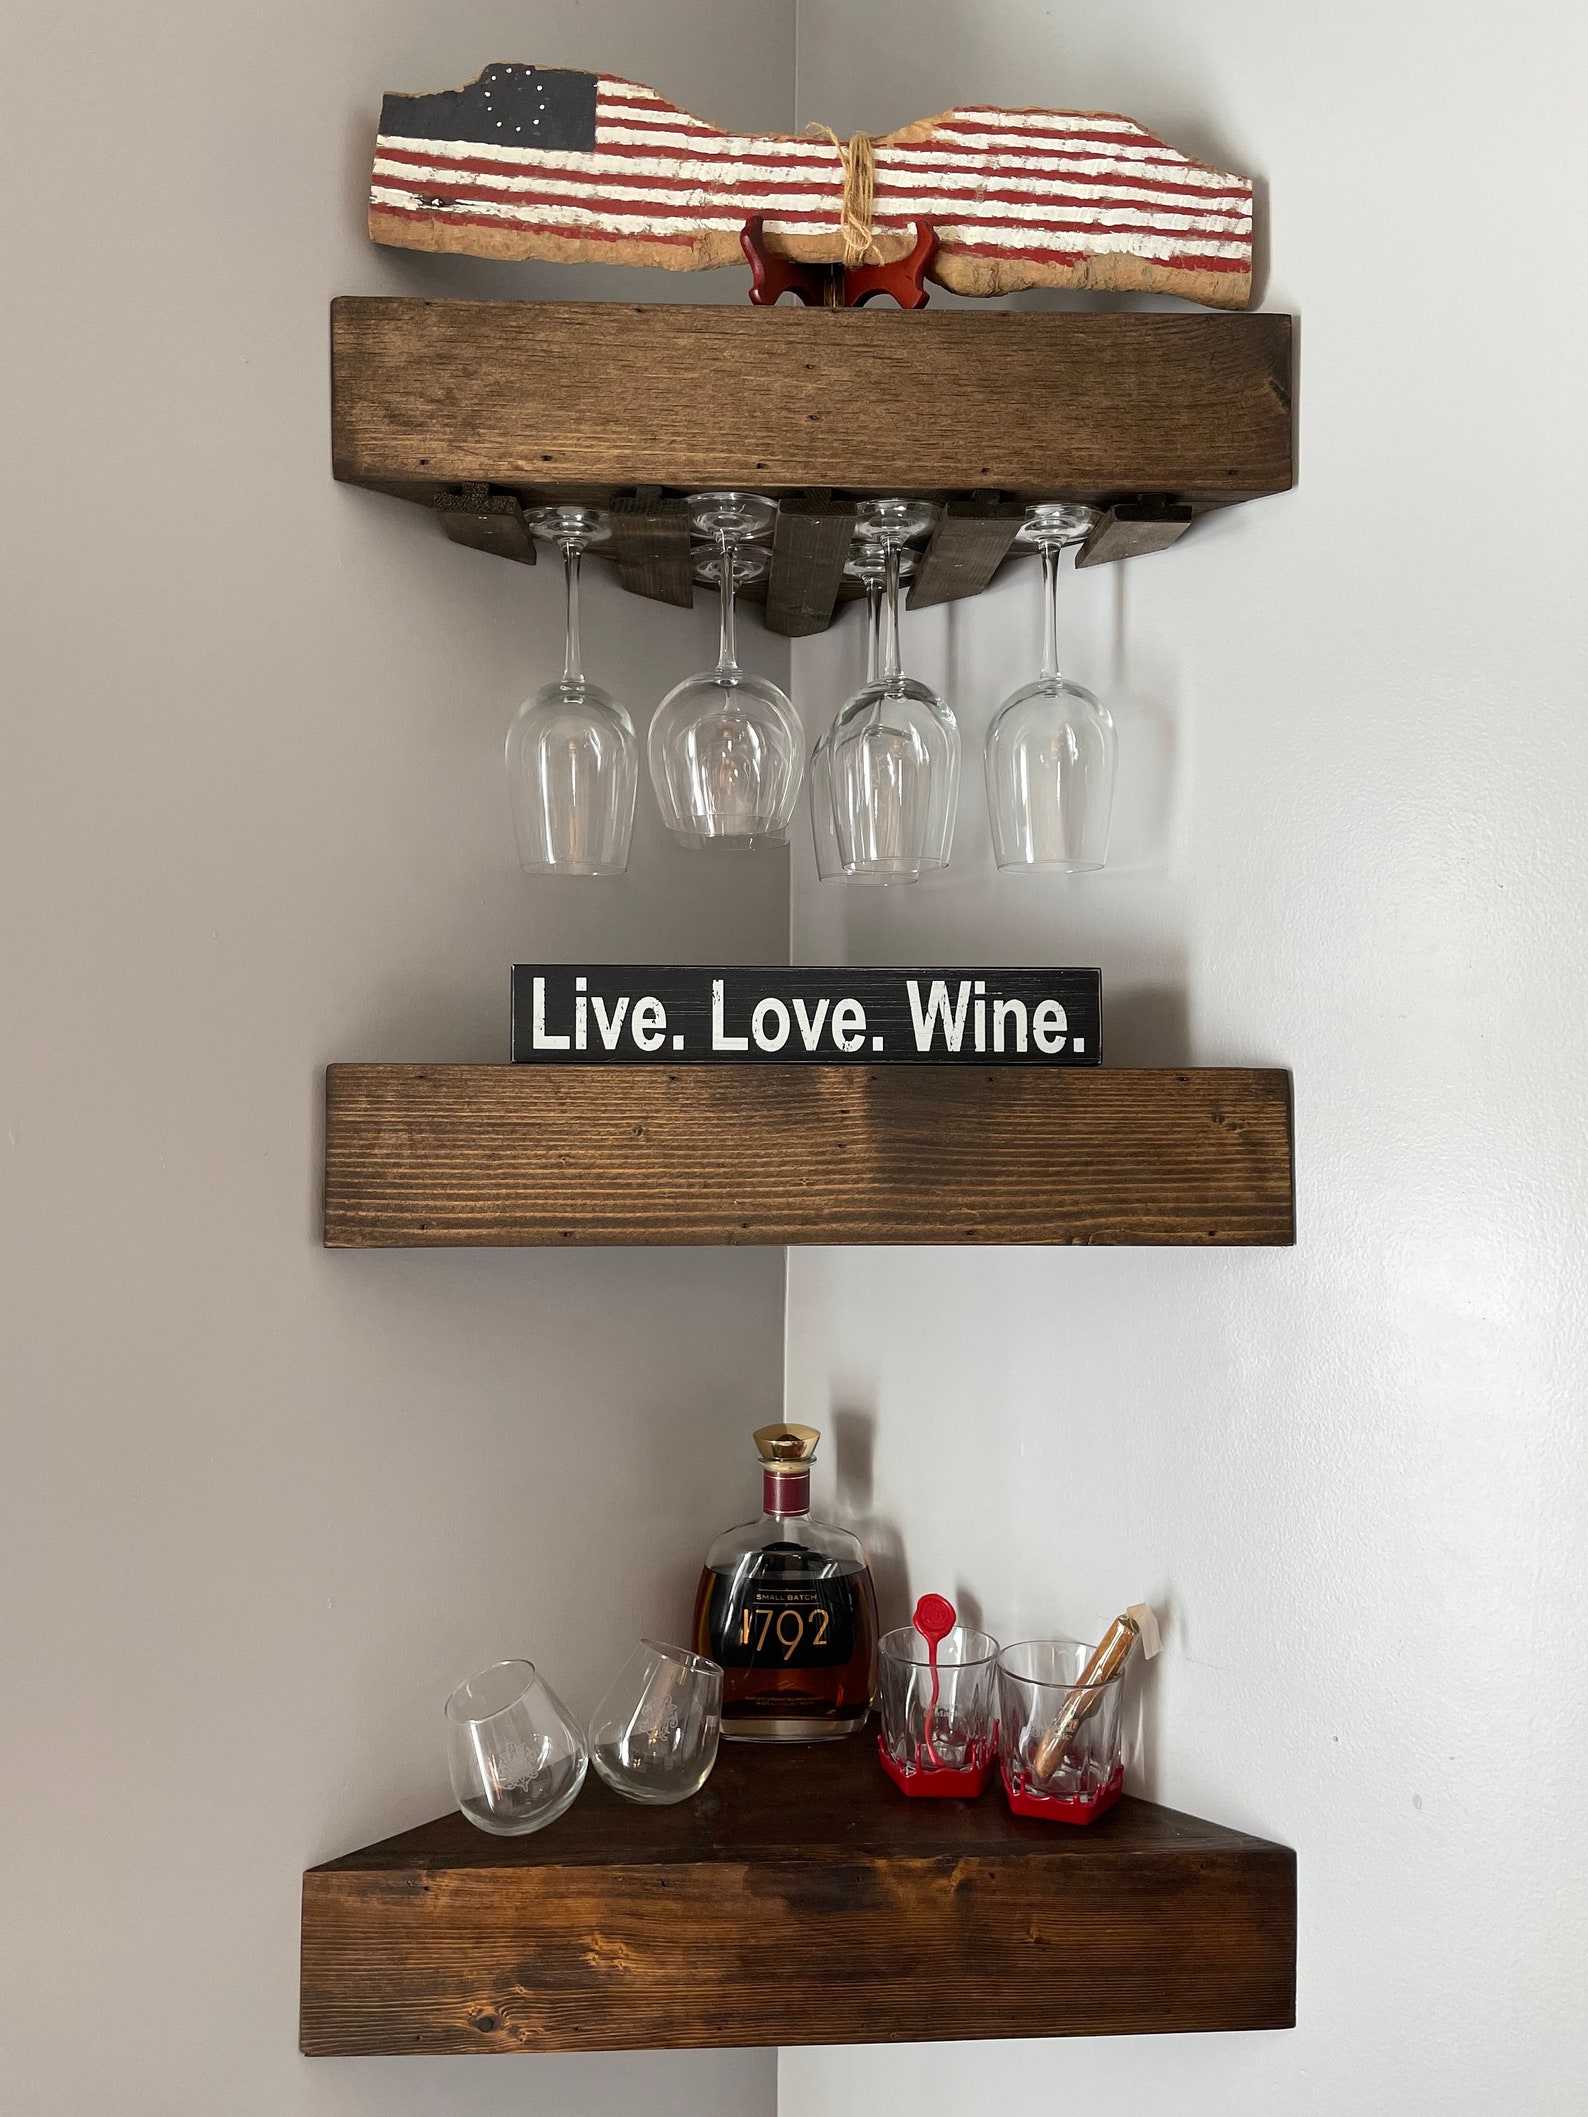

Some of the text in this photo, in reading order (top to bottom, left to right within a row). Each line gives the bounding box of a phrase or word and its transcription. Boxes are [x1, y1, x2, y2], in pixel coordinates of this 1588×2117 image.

[532, 977, 1085, 1054] Live. Love. Wine.
[756, 1593, 817, 1601] SMALL BATCH
[743, 1608, 829, 1661] 1792
